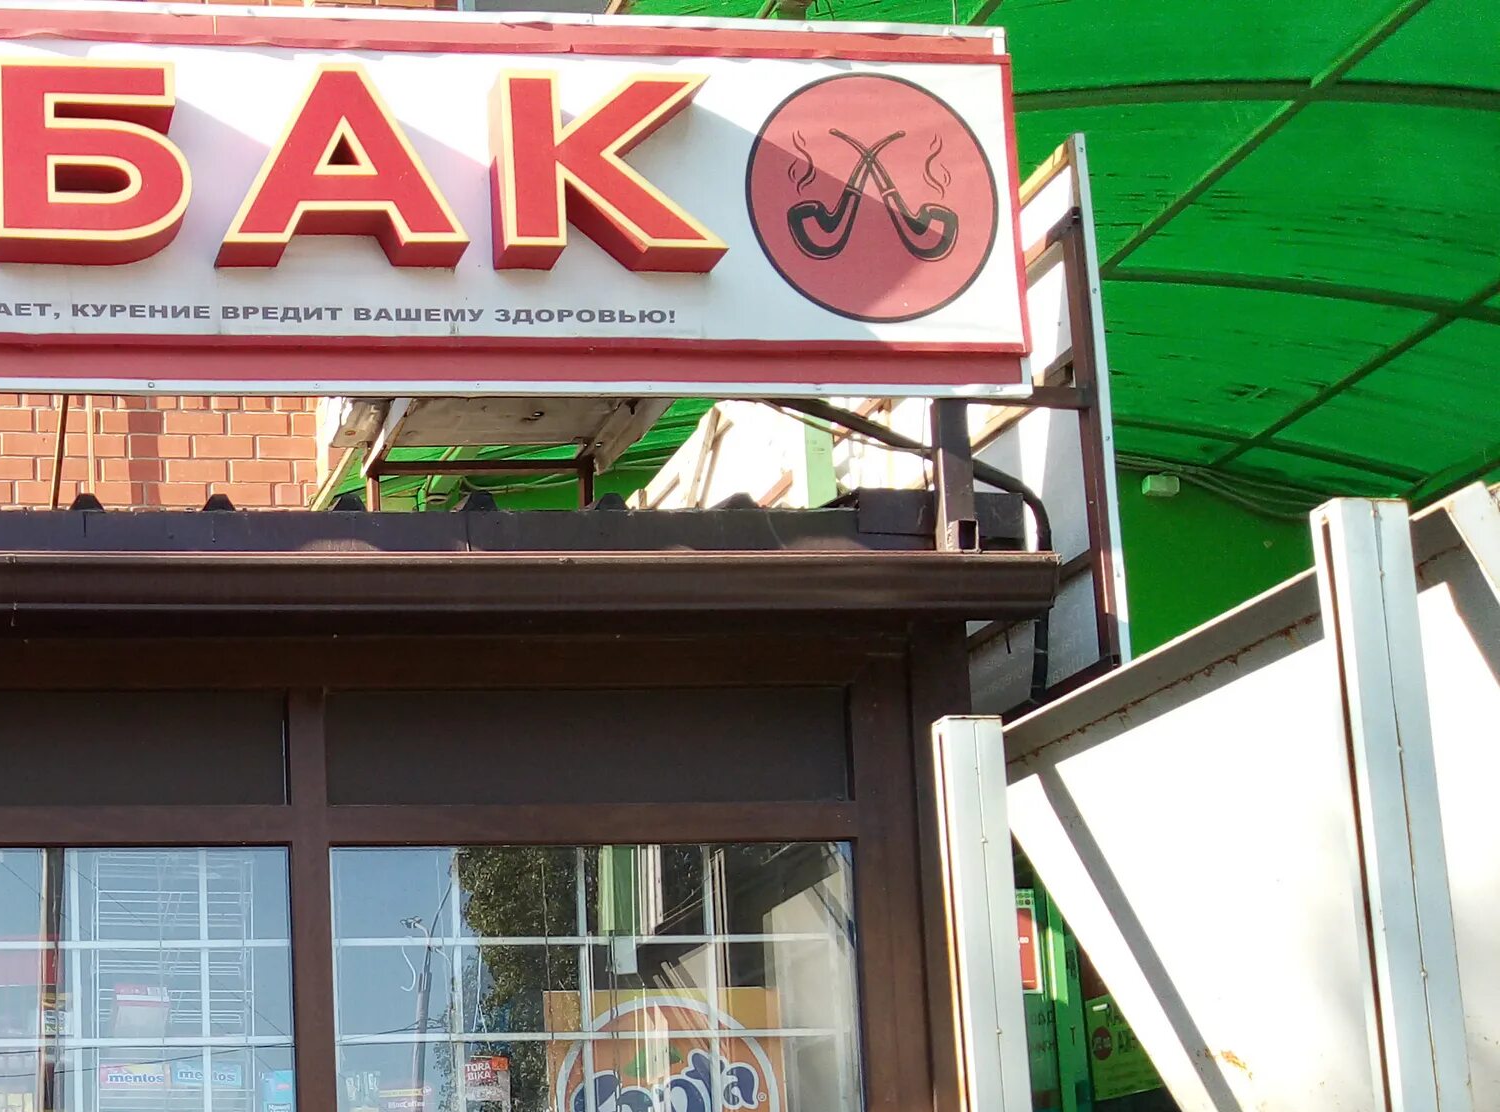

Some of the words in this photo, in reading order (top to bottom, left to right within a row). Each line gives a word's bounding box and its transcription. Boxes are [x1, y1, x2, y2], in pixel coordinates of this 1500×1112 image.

[71, 301, 212, 321] КУРЕНИЕ
[221, 304, 342, 326] ВРЕДИТ
[353, 305, 485, 326] ВАШЕМУ
[494, 306, 677, 327] ЗДОРОВЬЮ!
[108, 1072, 165, 1083] mentos
